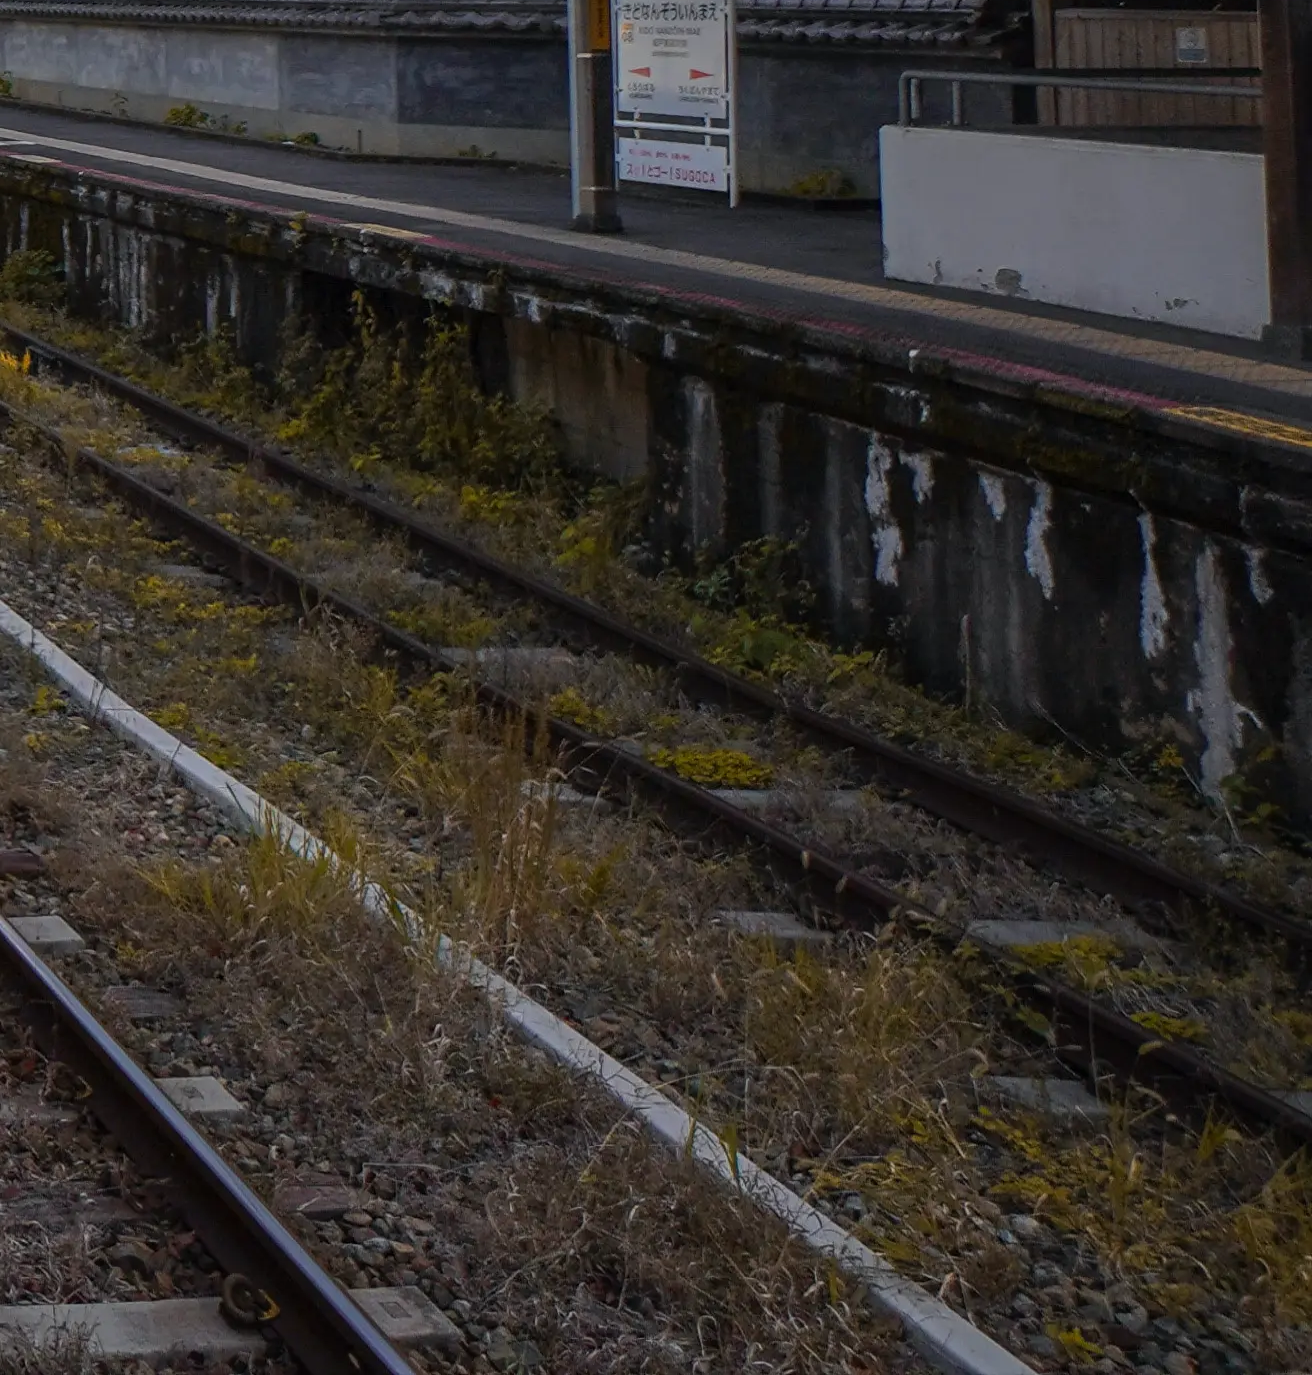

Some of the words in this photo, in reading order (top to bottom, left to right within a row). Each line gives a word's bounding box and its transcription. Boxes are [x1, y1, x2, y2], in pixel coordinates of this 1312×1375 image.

[622, 2, 718, 21] きどなんぞういんまえ
